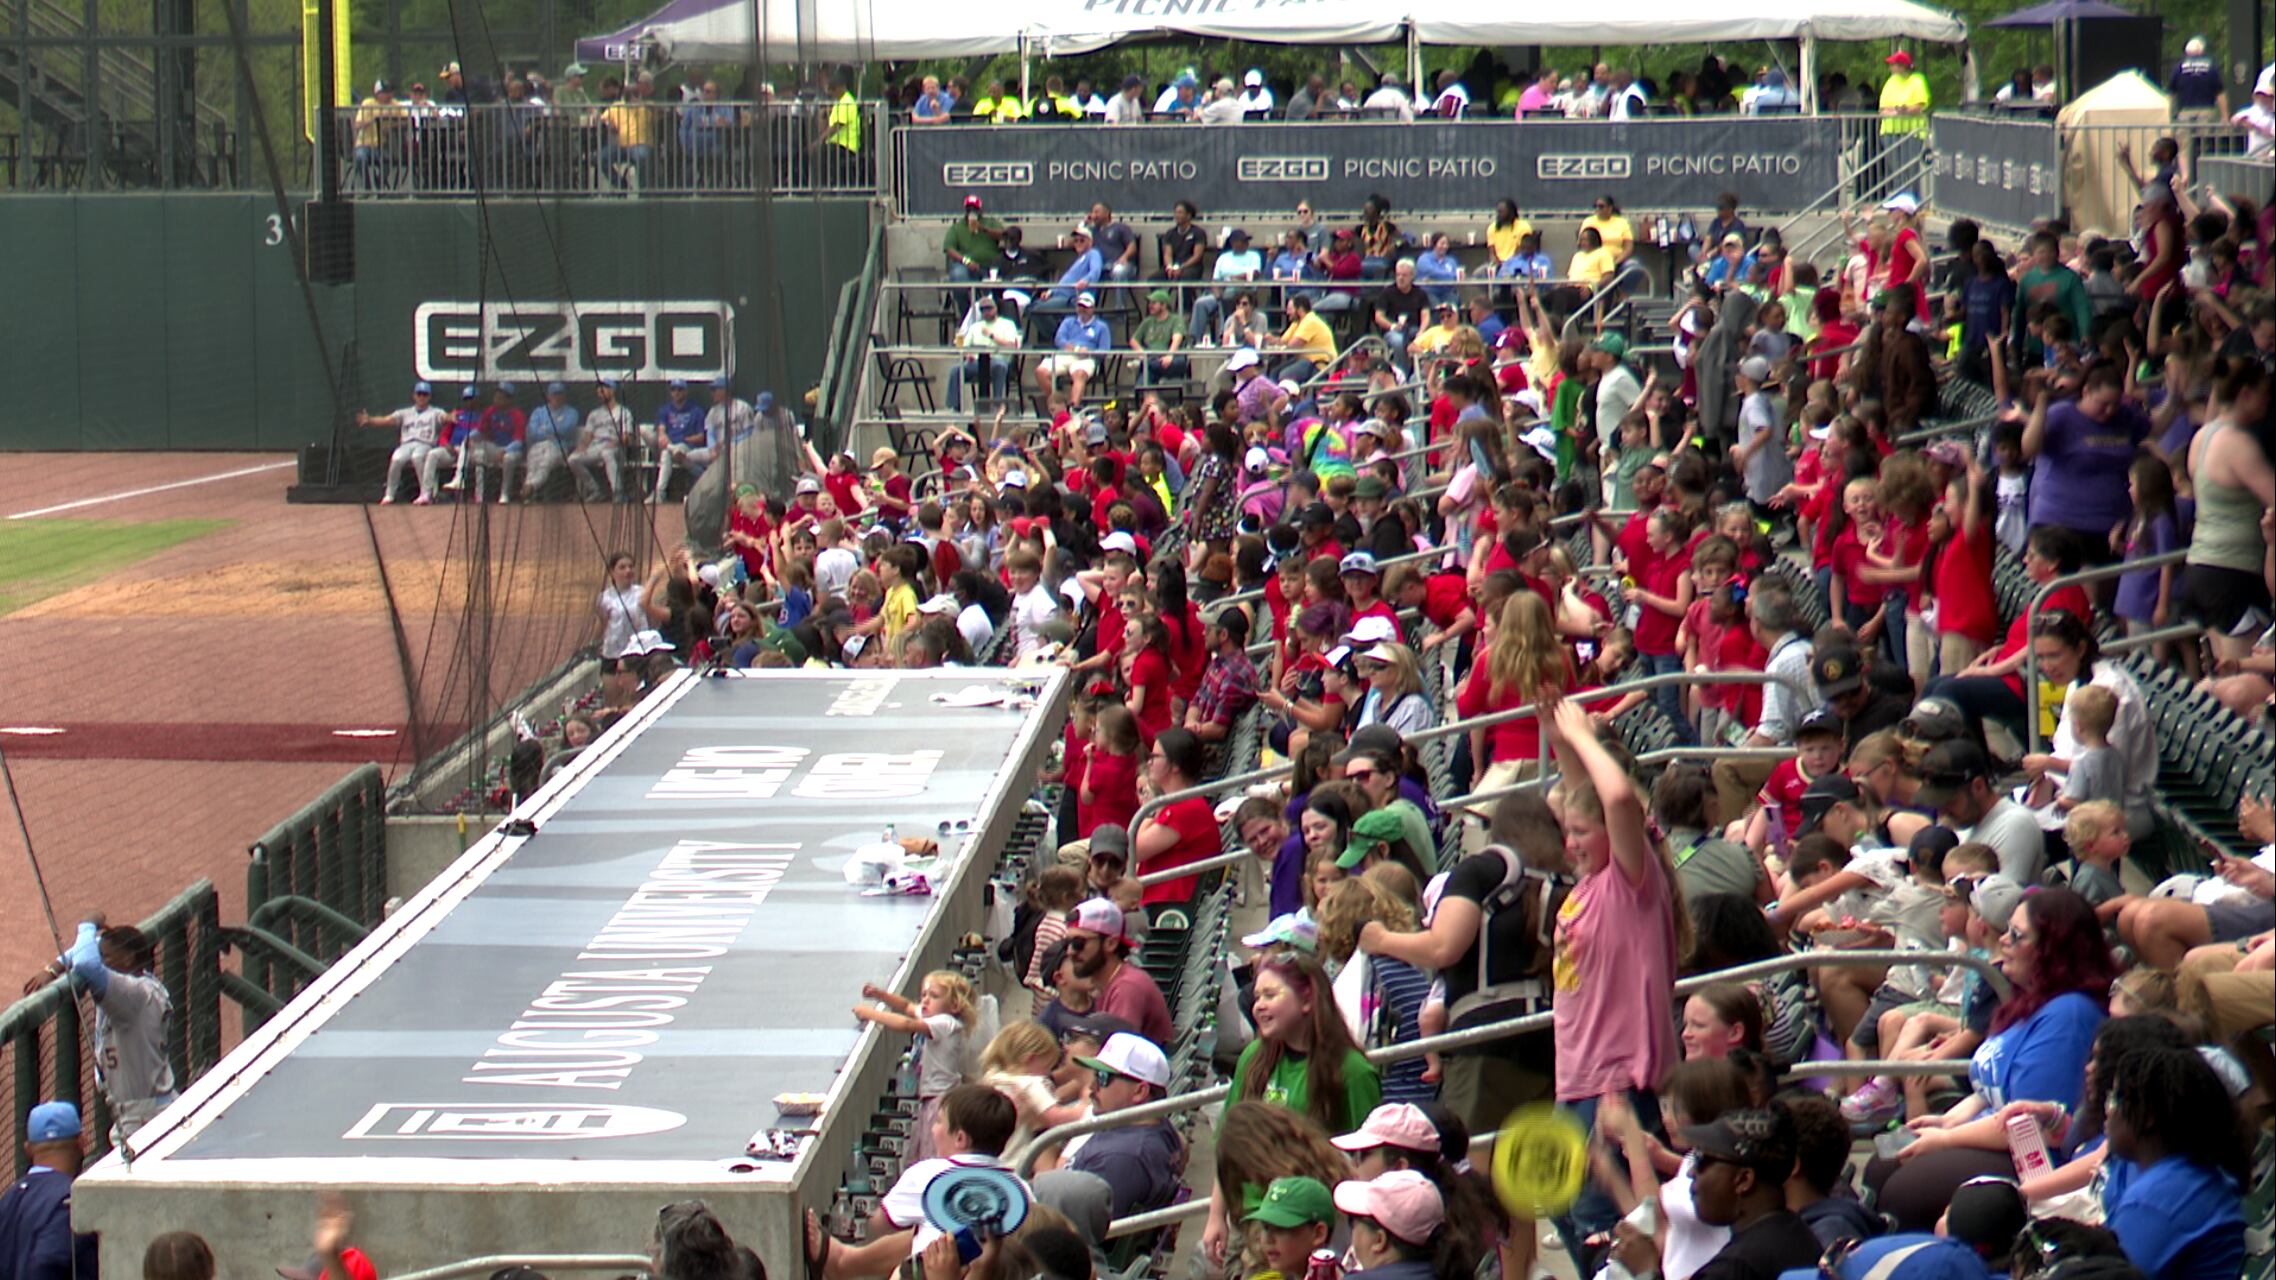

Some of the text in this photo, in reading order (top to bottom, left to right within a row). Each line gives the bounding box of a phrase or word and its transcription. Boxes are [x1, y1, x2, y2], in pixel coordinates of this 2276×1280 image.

[945, 160, 1197, 185] EZGO PICNIC PATIO
[1239, 157, 1496, 179] EZGO PICNIC PATIO
[1539, 154, 1800, 177] EZGO PICNIC PATIO
[421, 308, 728, 375] EZGO
[462, 839, 803, 1090] AUGUSTA UNIVERSITY
